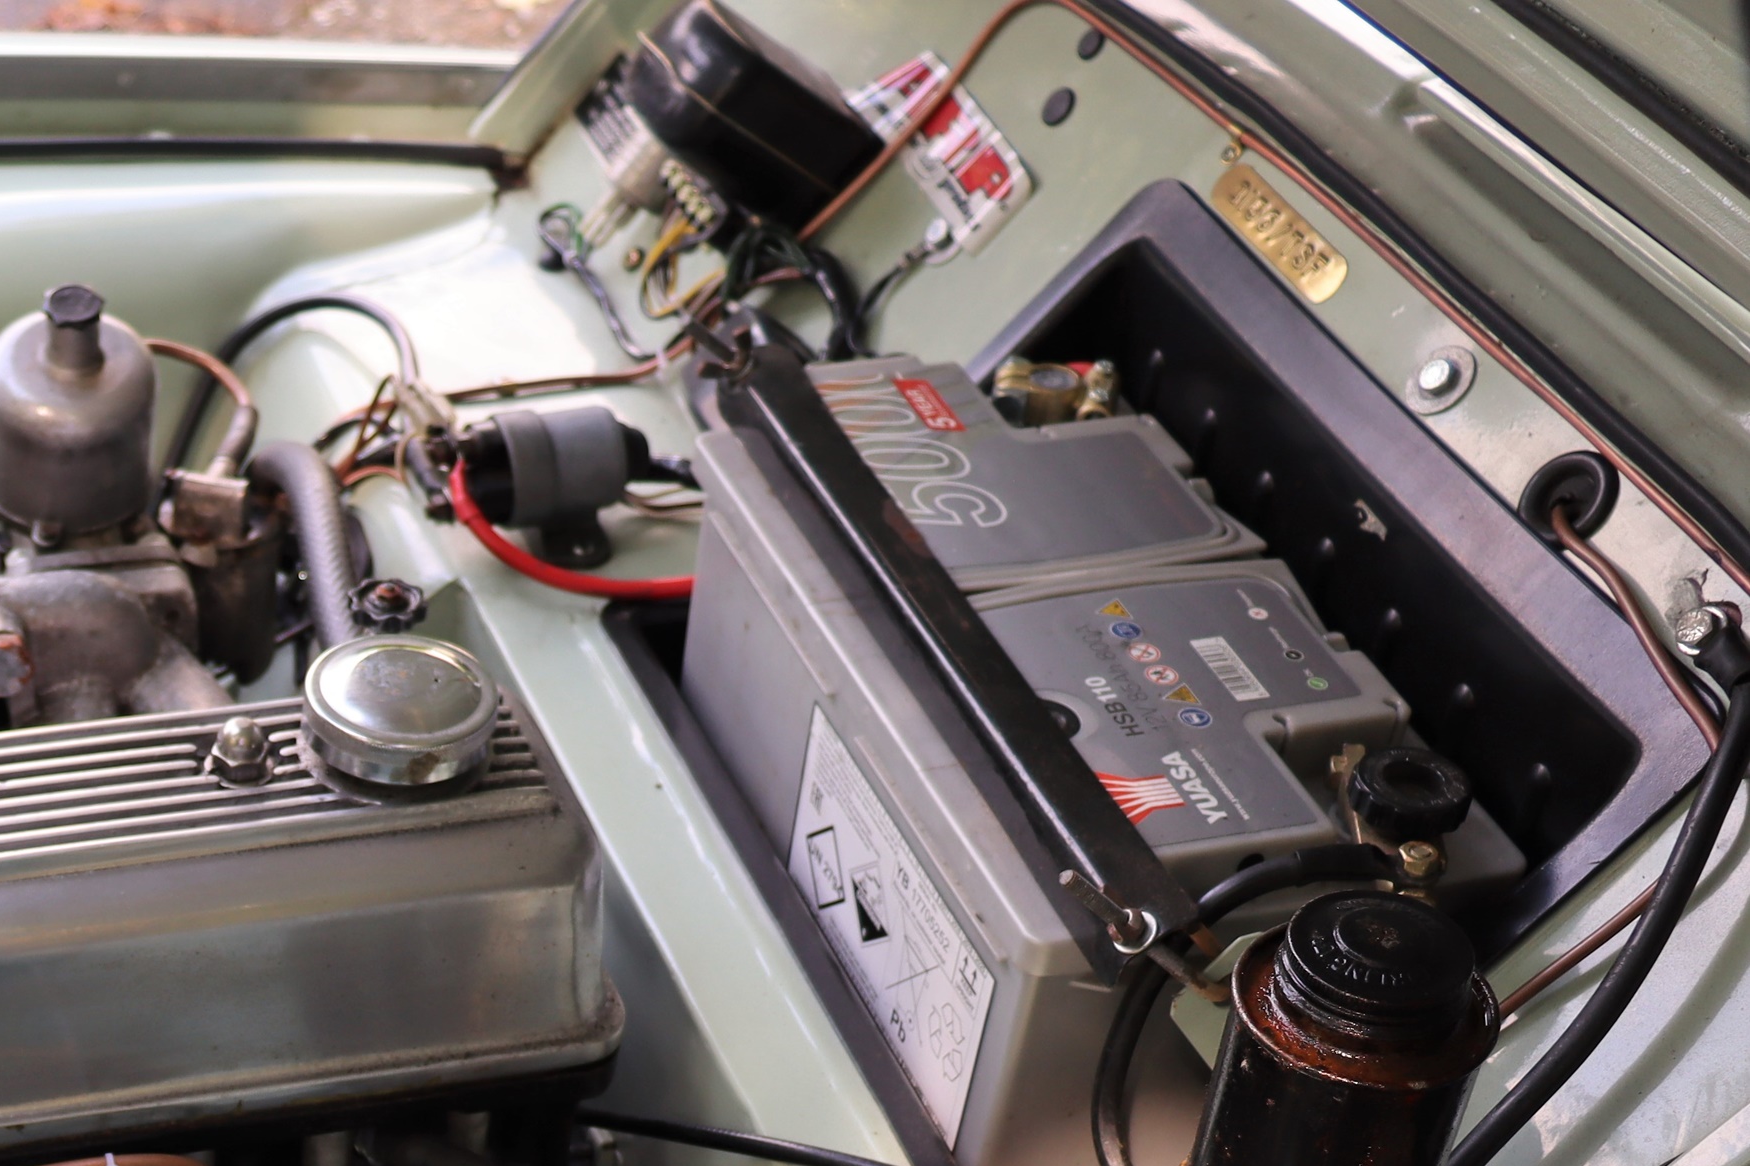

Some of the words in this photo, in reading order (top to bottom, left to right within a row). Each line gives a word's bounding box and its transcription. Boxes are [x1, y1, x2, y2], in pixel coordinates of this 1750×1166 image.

[906, 388, 934, 419] YEAR
[1161, 751, 1228, 825] YUASA
[890, 1008, 906, 1044] Pb
